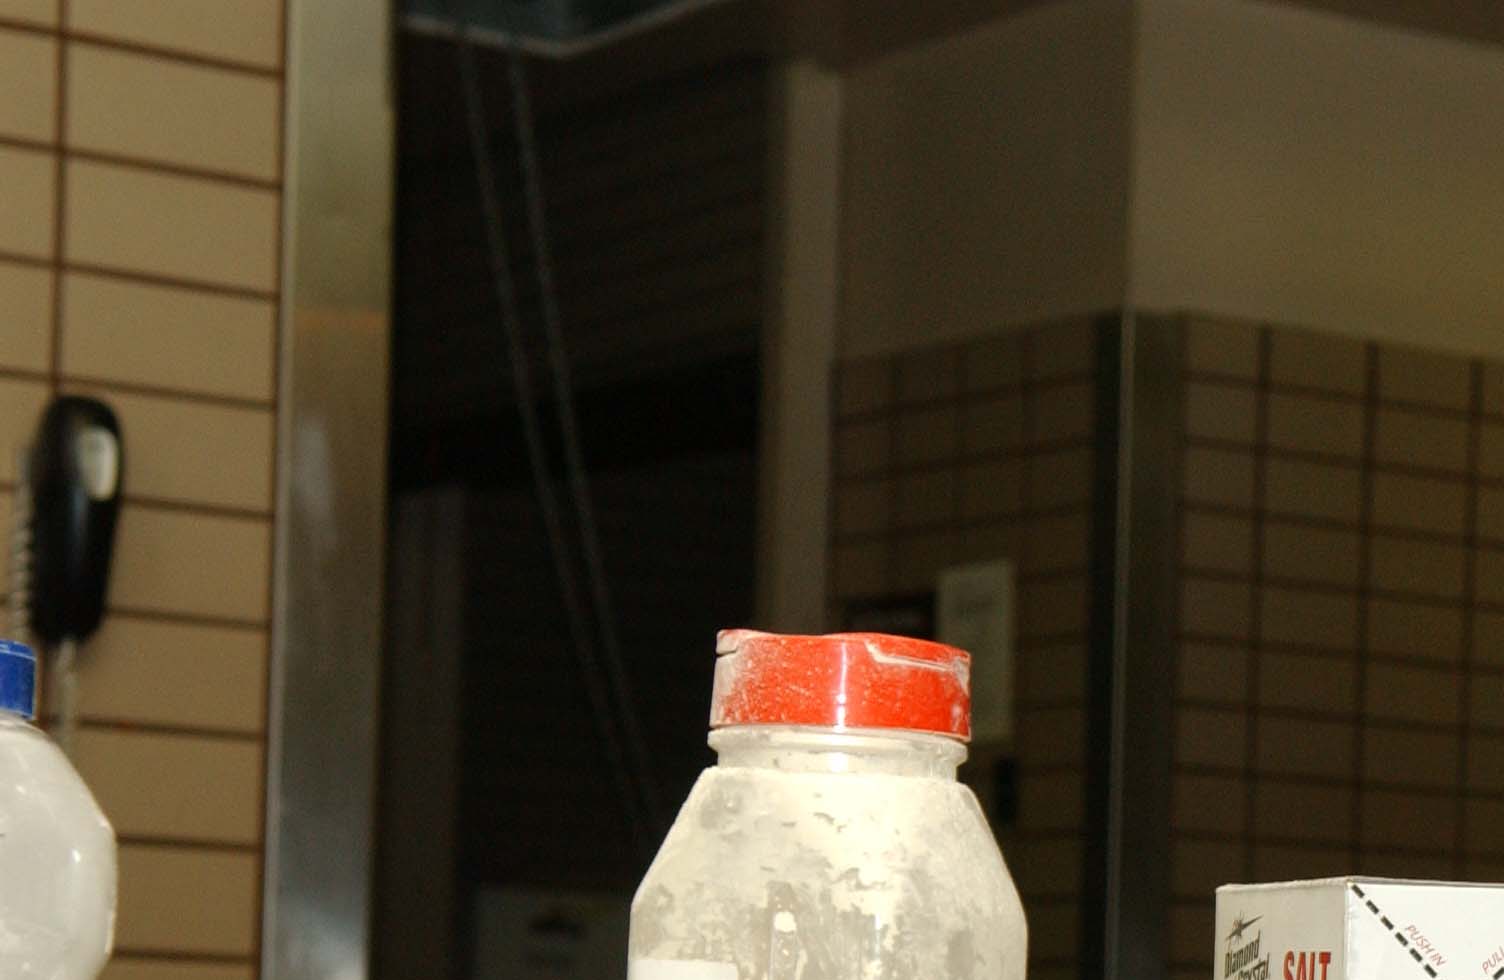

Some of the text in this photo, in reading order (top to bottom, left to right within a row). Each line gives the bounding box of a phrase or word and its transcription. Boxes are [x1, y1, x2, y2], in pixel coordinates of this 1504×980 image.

[1224, 929, 1261, 980] Diamond
[1405, 925, 1447, 967] PUSH IN
